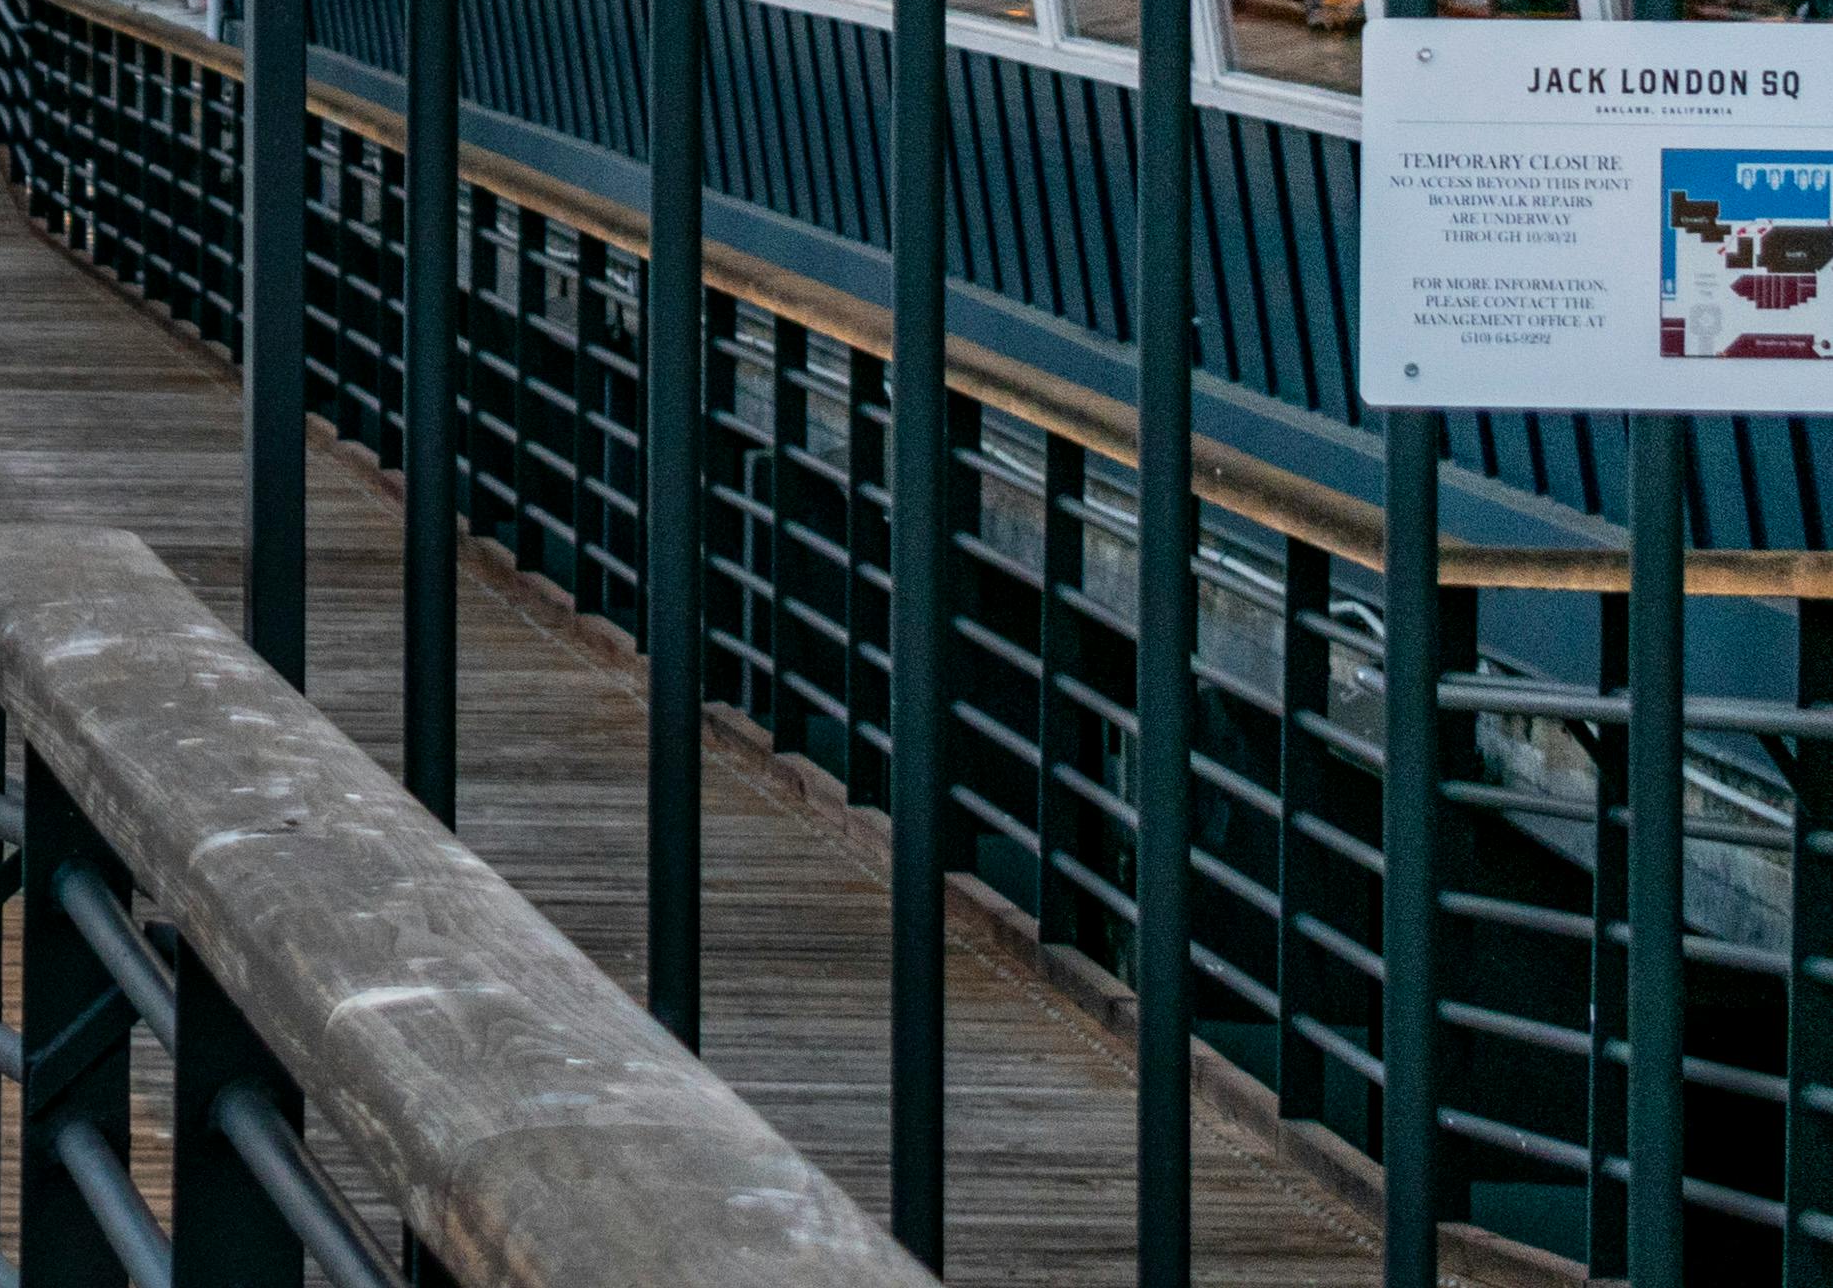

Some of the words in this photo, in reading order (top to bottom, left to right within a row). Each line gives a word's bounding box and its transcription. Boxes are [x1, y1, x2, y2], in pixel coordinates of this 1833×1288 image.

[1527, 67, 1607, 94] JACK
[1621, 68, 1748, 96] LONDON
[1762, 70, 1800, 100] SQ
[1399, 153, 1524, 170] TEMPORARY
[1529, 155, 1623, 171] CLOSURE
[1390, 176, 1413, 188] NO
[1418, 176, 1472, 189] ACCESS
[1477, 177, 1540, 190] BEYOND
[1545, 178, 1580, 190] THIS
[1583, 178, 1632, 191] POINT
[1428, 194, 1528, 207] BOARDWALK
[1532, 196, 1593, 208] REPAIRS
[1450, 213, 1478, 224] ARE
[1482, 214, 1571, 225] UNDERWAY
[1442, 230, 1521, 243] THROUGH
[1412, 278, 1442, 290] FOR
[1446, 278, 1490, 290] MORE
[1425, 296, 1480, 307] PLEASE
[1483, 296, 1560, 309] CONTACT
[1563, 297, 1595, 309] THE
[1413, 313, 1527, 326] MANAGEMENT
[1528, 314, 1580, 327] OFFICE
[1583, 316, 1607, 327] AT
